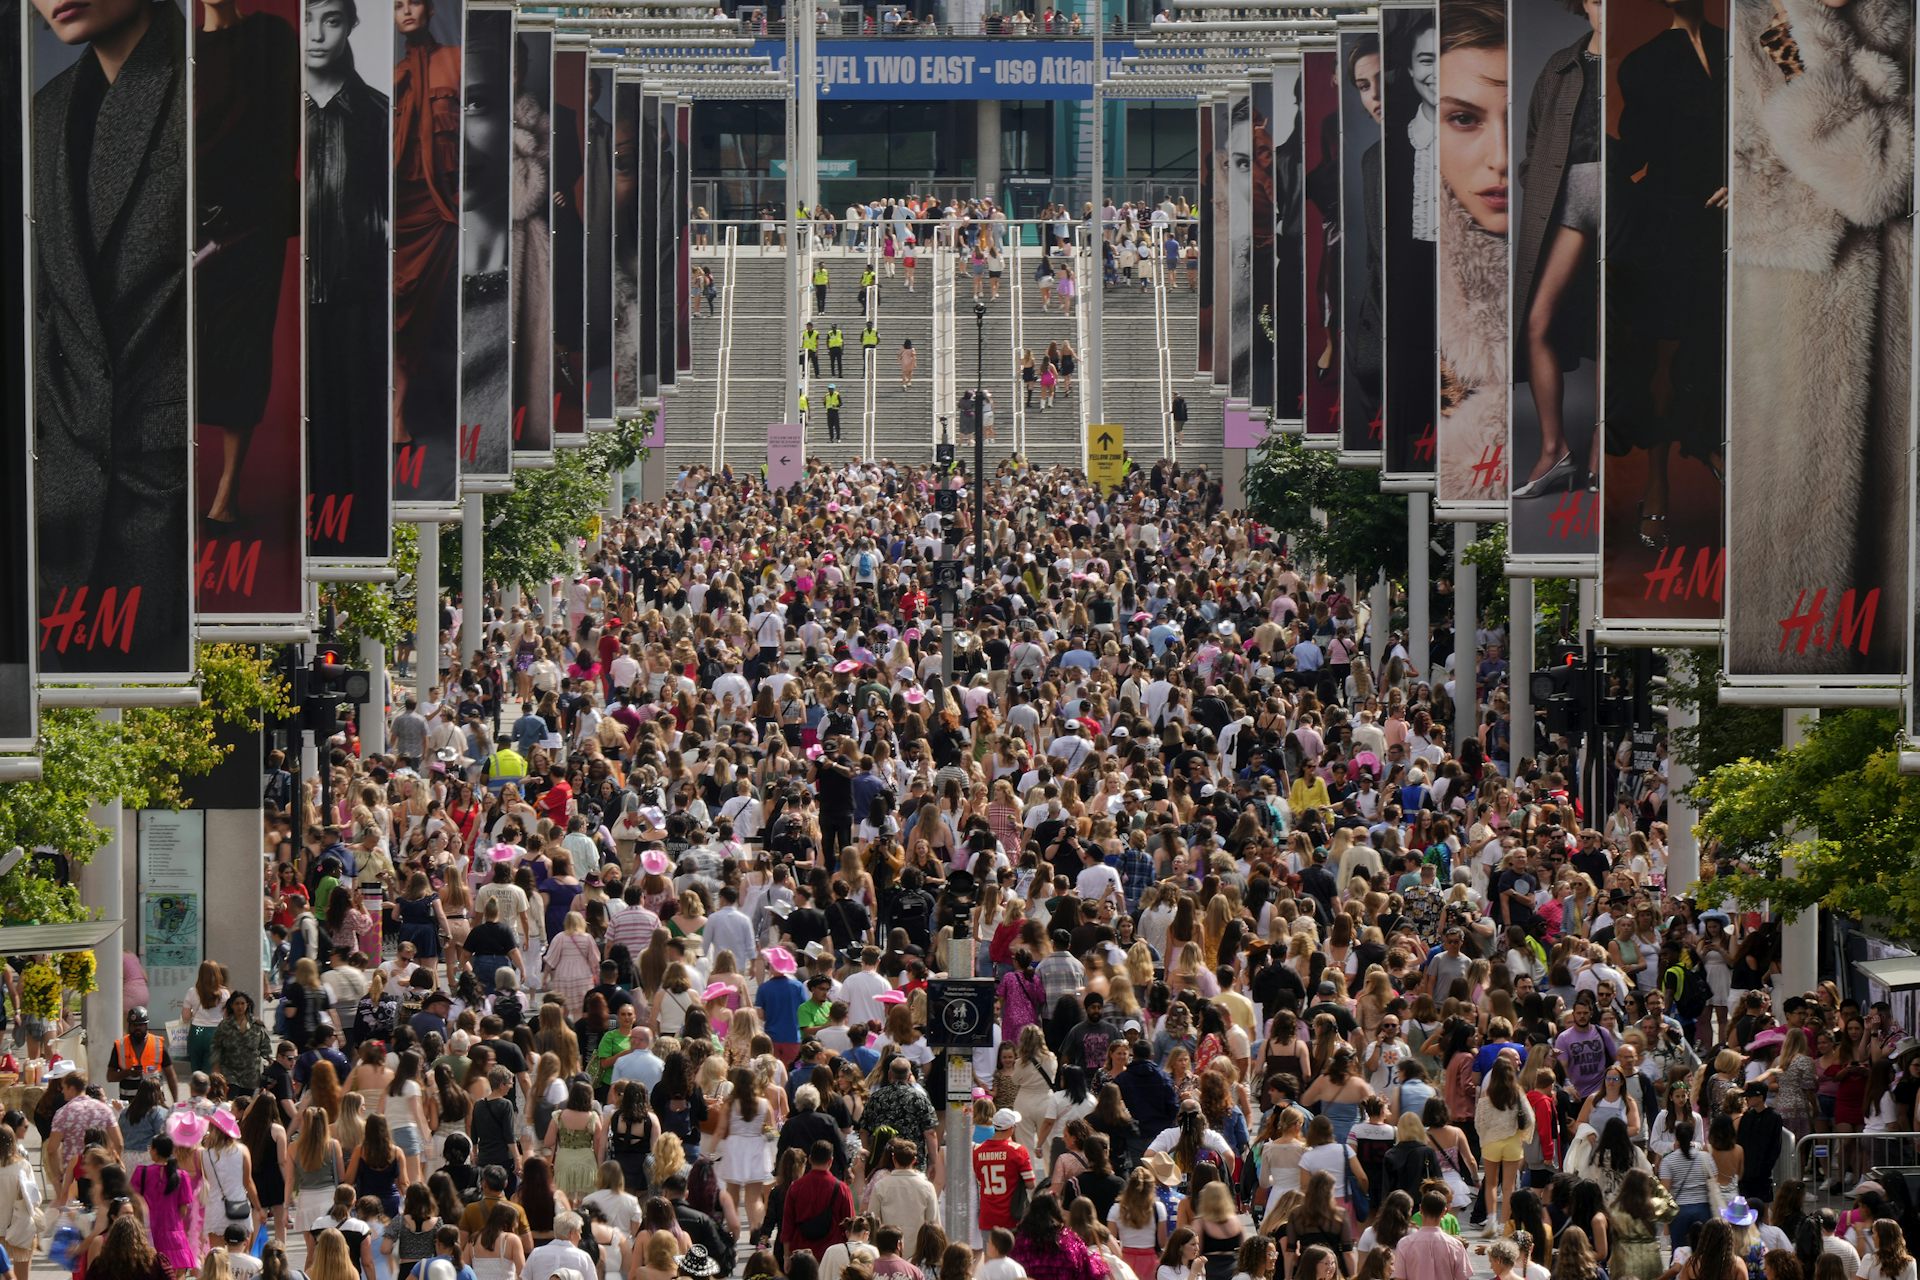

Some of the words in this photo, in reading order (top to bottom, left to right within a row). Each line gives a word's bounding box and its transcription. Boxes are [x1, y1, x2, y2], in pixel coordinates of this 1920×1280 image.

[864, 56, 916, 84] TWO
[920, 56, 976, 84] EAST
[995, 59, 1036, 84] use
[40, 586, 142, 653] H&M
[1778, 588, 1881, 656] H&M
[978, 1152, 1008, 1161] MAHOMES
[981, 1164, 1007, 1195] 15
